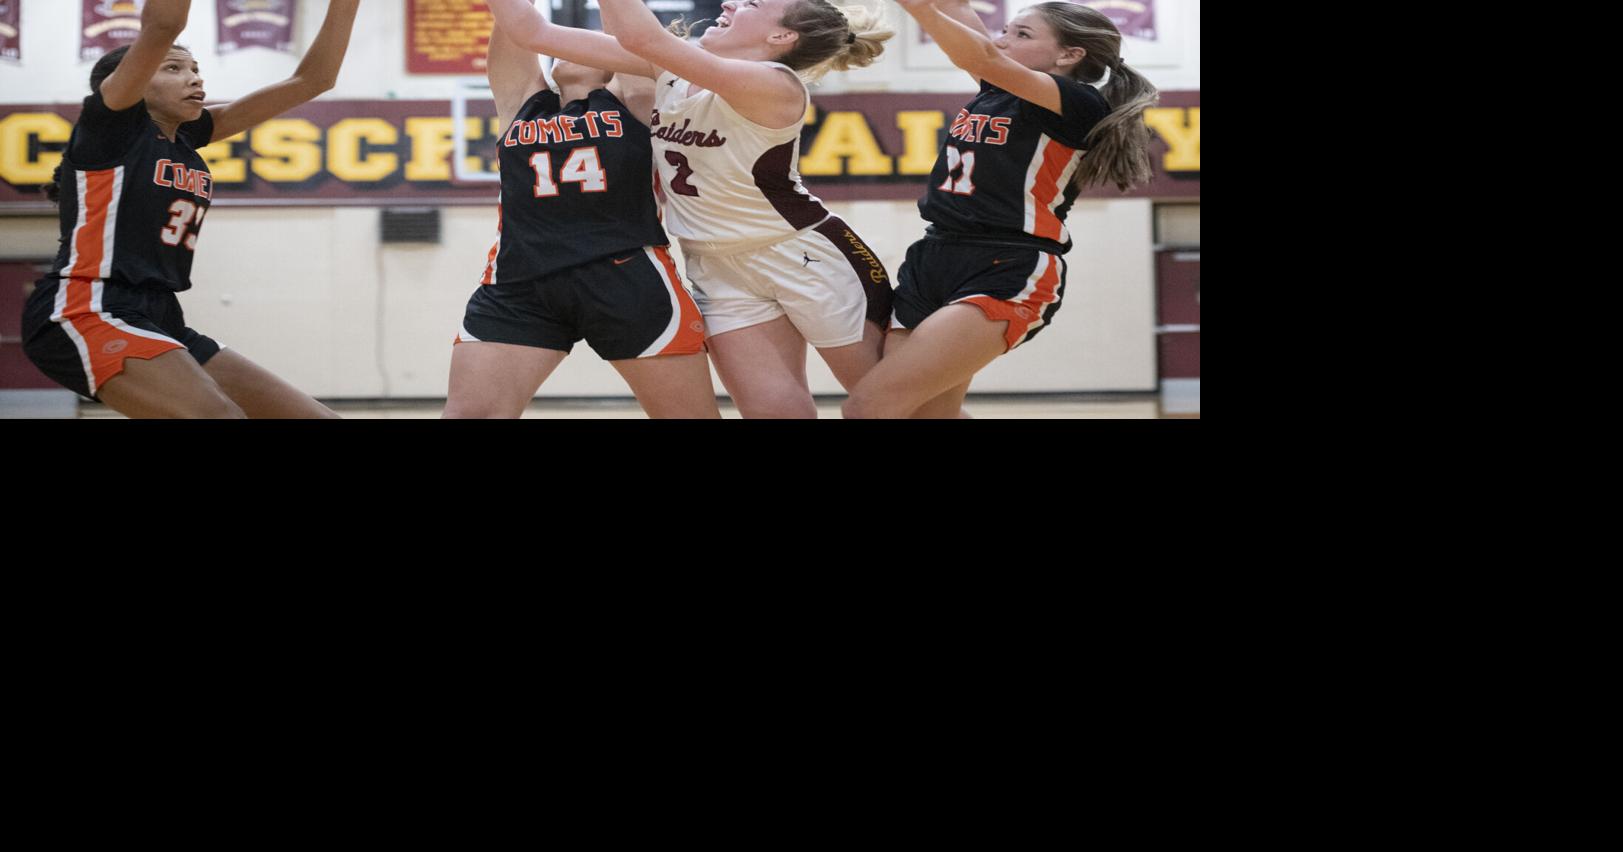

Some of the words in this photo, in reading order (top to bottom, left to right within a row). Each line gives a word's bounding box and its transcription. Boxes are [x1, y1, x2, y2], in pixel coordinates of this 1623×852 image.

[504, 110, 624, 148] COMETS
[528, 145, 607, 198] 14
[664, 149, 700, 198] 2
[843, 229, 888, 284] Raiders
